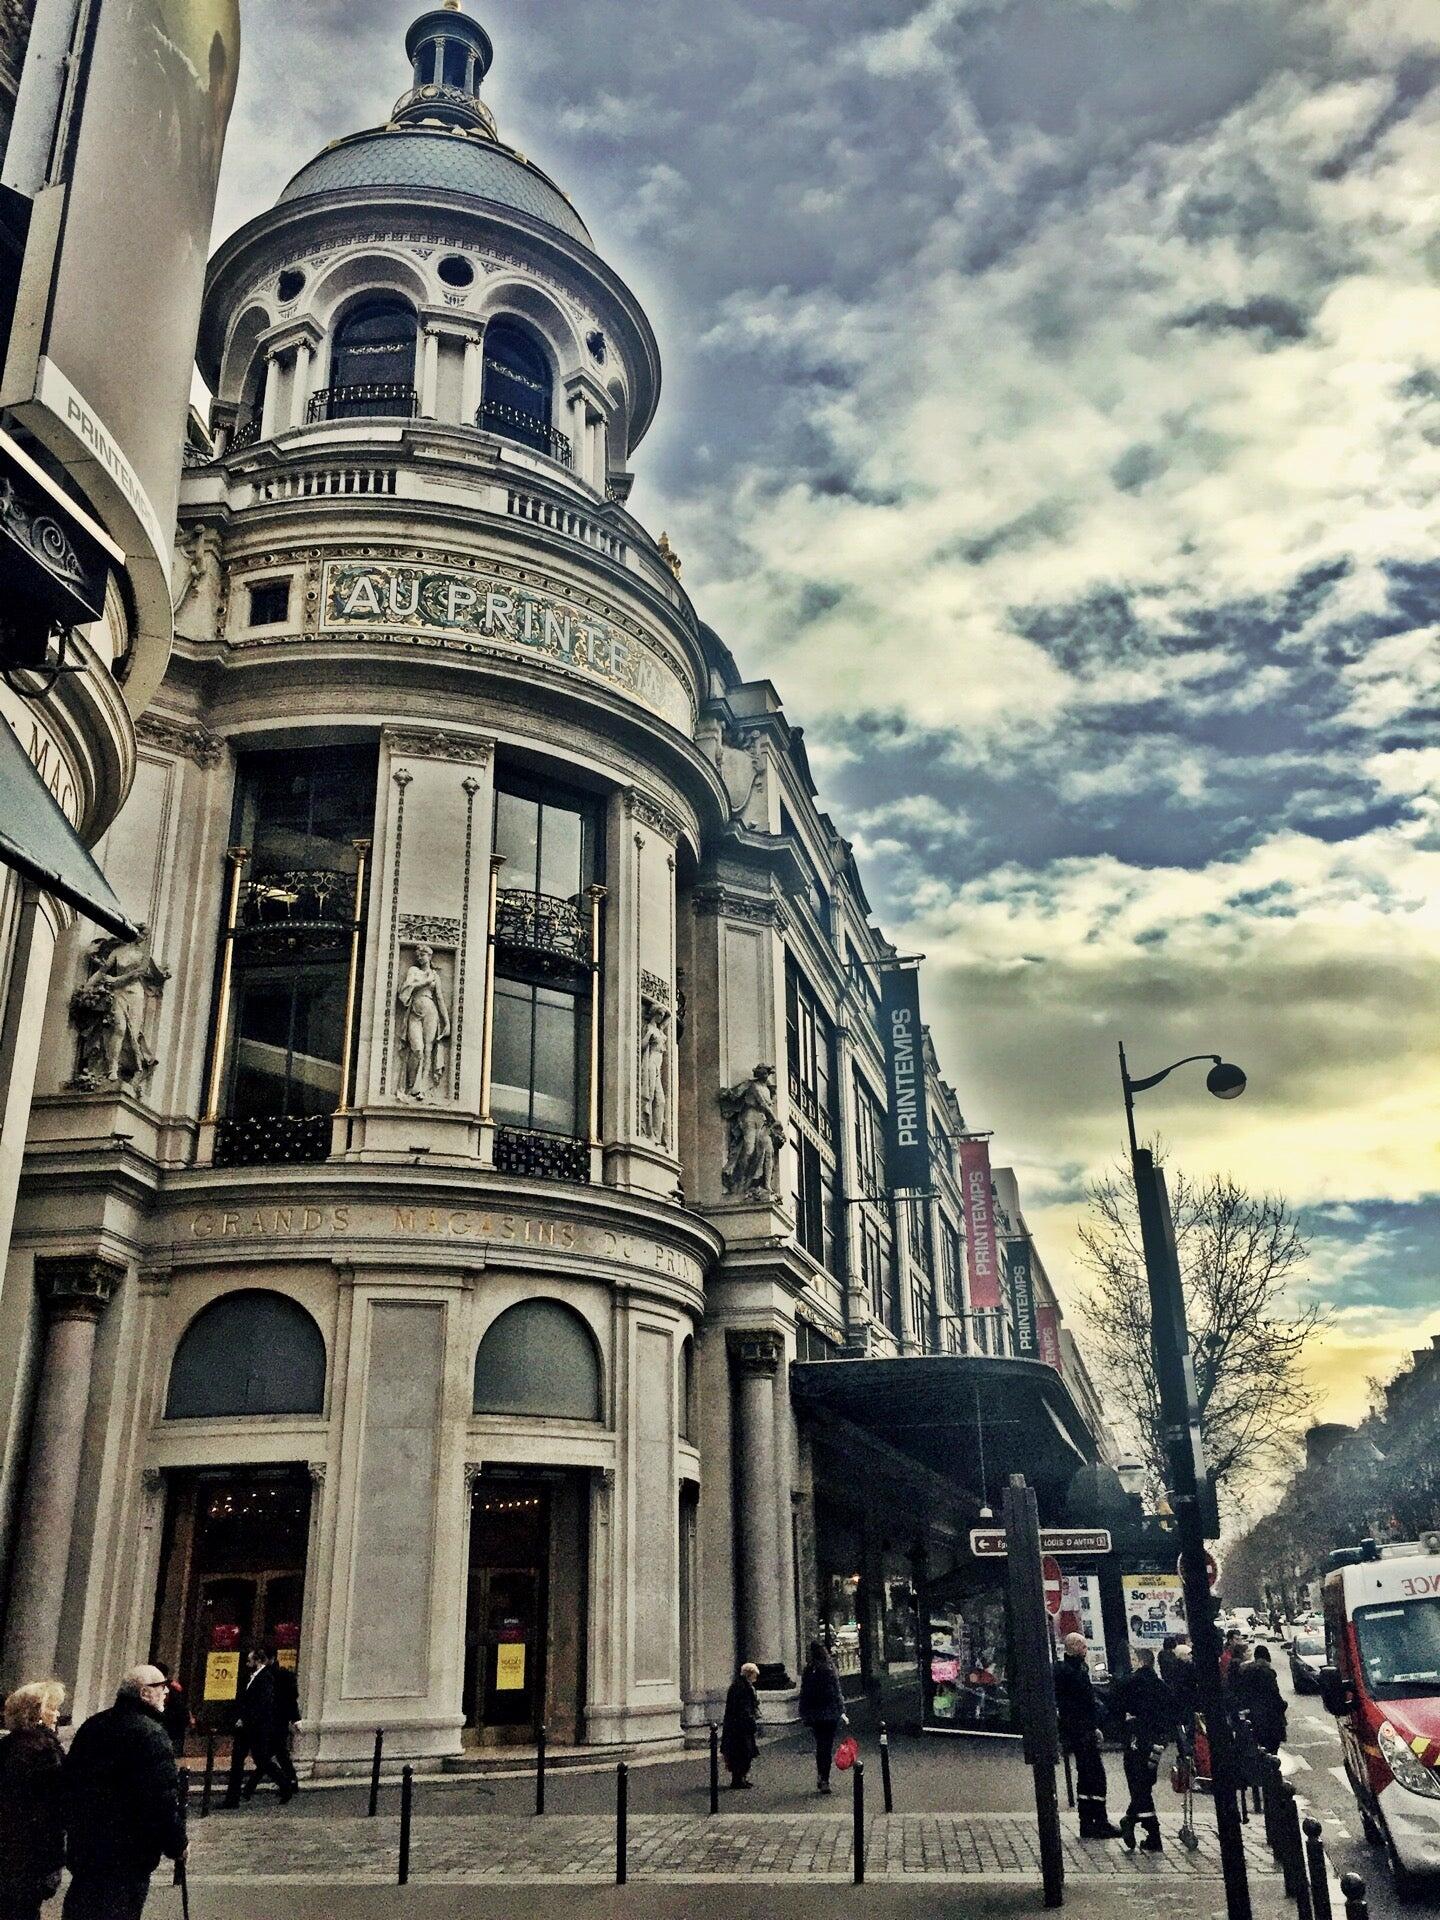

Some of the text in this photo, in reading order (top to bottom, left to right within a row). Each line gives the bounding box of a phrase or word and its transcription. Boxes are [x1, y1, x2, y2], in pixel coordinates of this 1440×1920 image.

[342, 576, 419, 616] AU
[891, 1008, 919, 1146] PRINTEMPS
[190, 1207, 350, 1238] GRANDS
[391, 1209, 575, 1249] MAGASINS
[969, 1171, 992, 1277] PRINTEMPS
[1013, 1265, 1032, 1350] PRINTEMPS
[1043, 1539, 1064, 1547] LOUIS
[1131, 1590, 1175, 1603] Society
[1143, 1620, 1167, 1632] BFM
